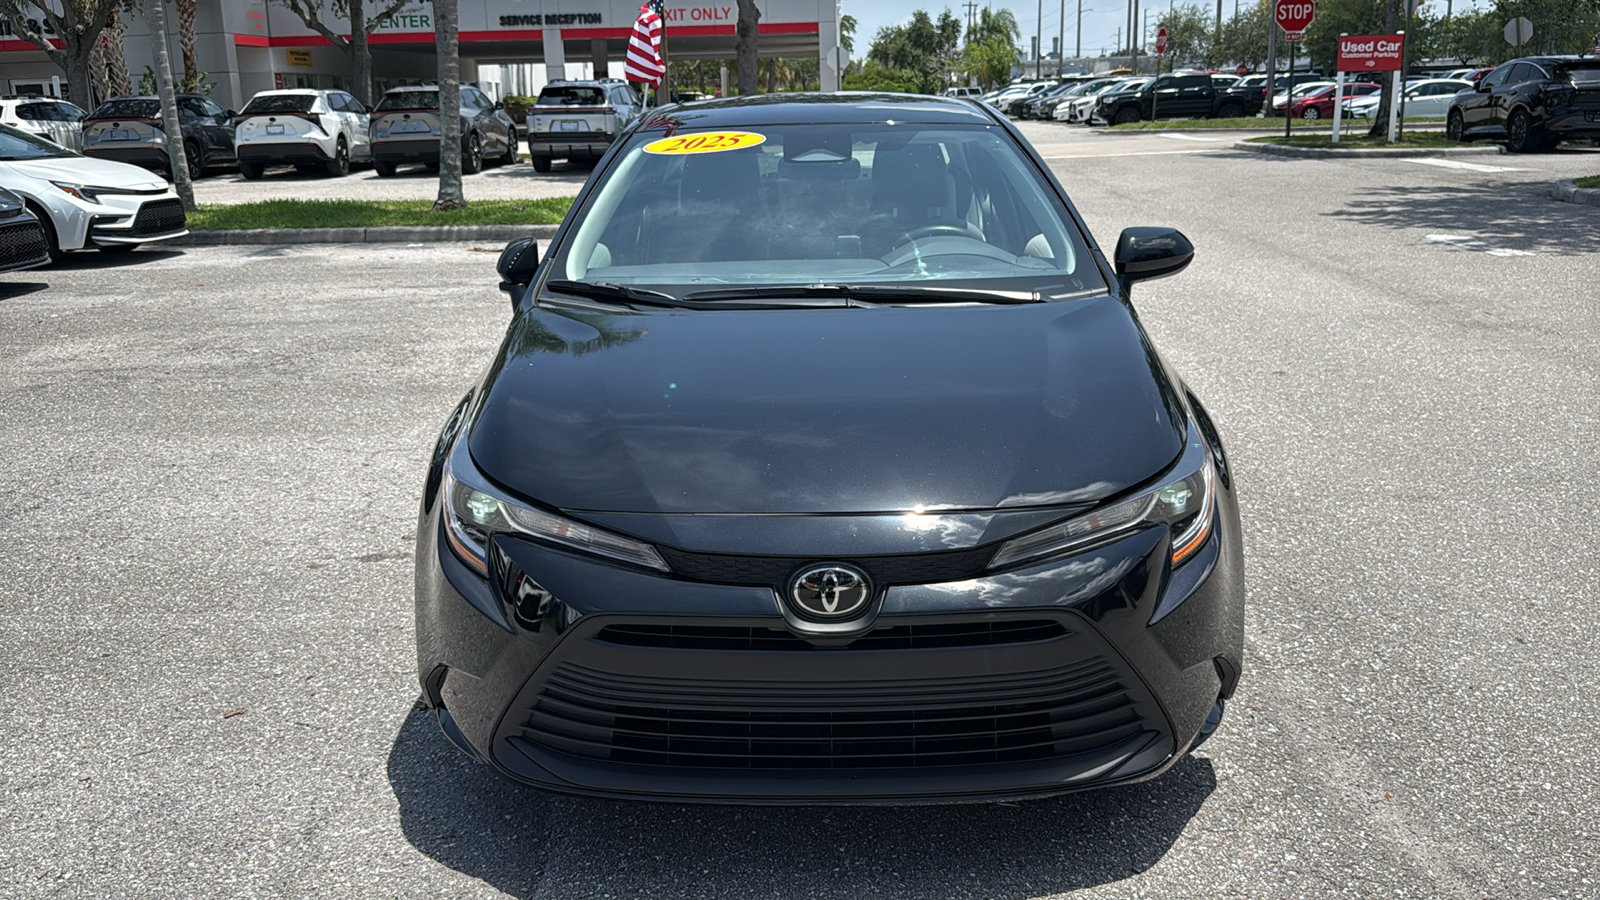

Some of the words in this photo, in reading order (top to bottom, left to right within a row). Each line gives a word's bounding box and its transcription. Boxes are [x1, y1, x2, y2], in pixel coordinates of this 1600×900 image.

[664, 9, 686, 21] XIT
[691, 7, 731, 20] ONLY
[1278, 4, 1312, 20] STOP
[499, 15, 542, 26] SERVICE
[544, 13, 602, 25] RECEPTION
[1341, 41, 1374, 52] Used
[1376, 40, 1400, 51] Car
[661, 133, 748, 153] 2025
